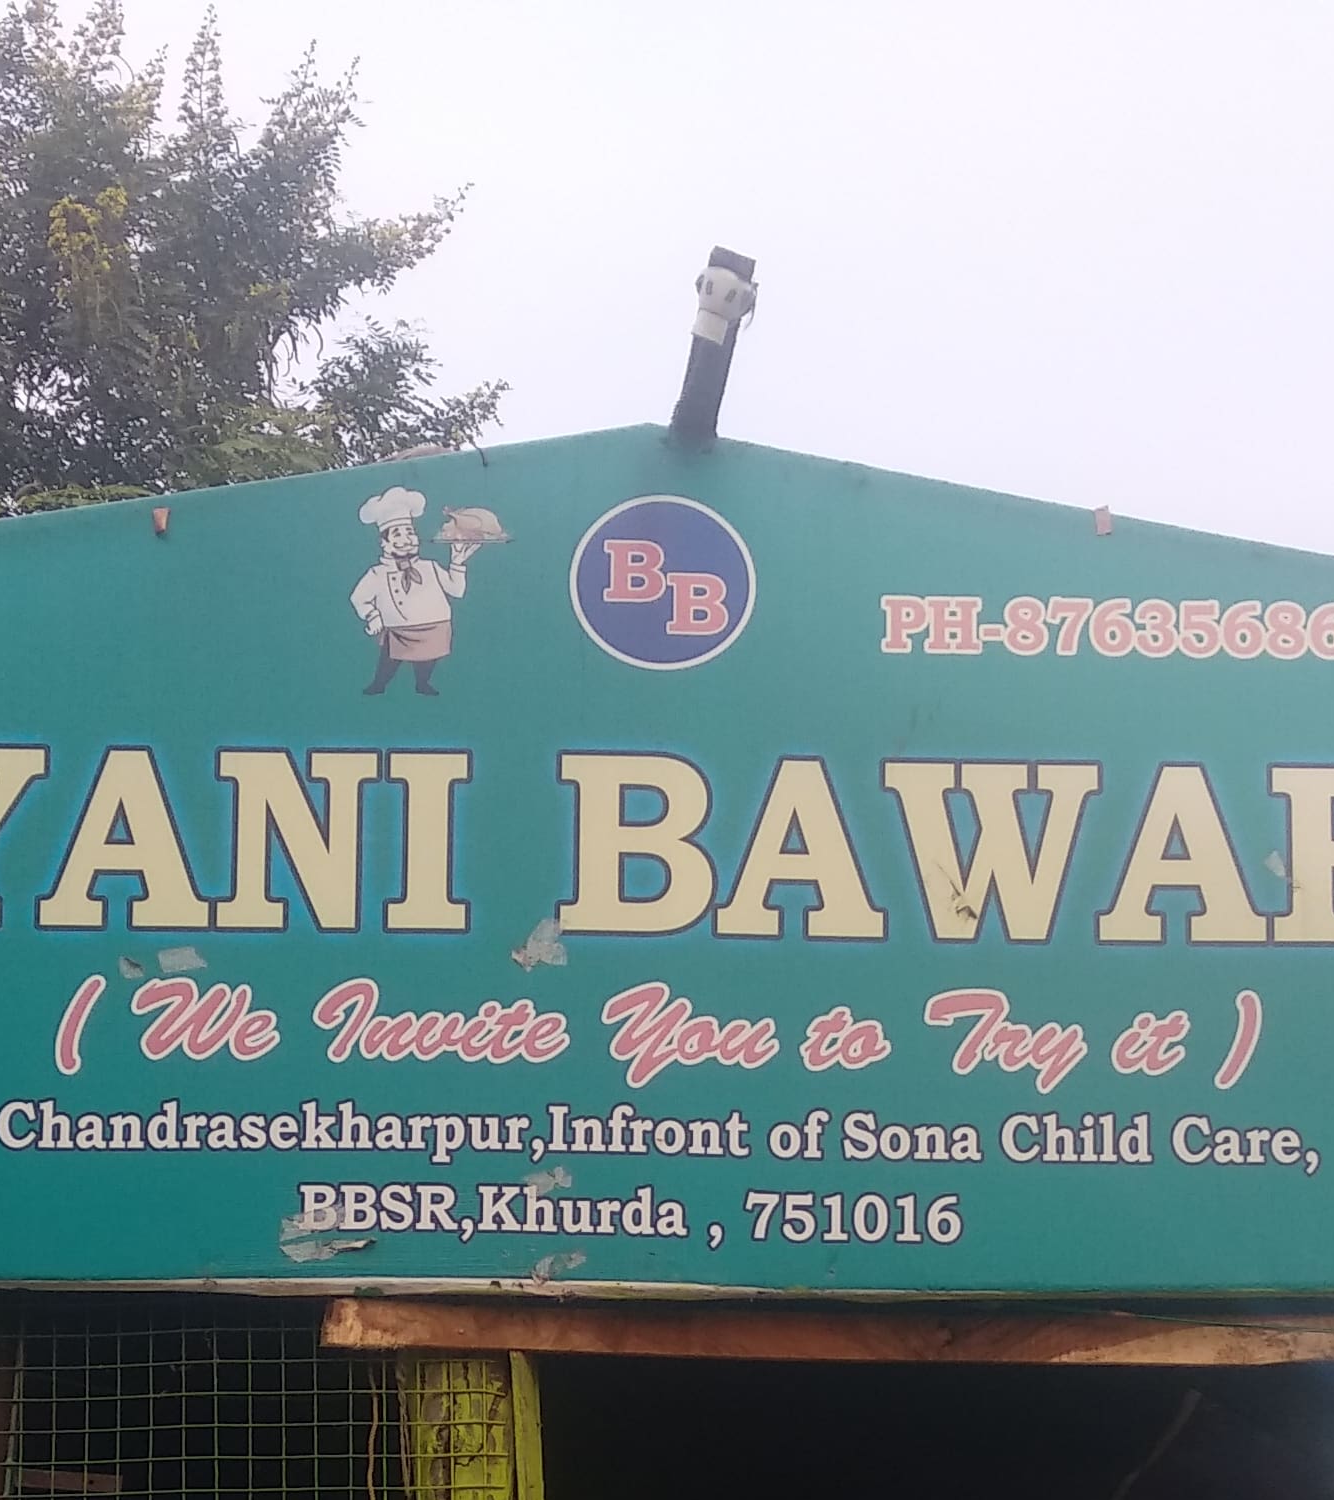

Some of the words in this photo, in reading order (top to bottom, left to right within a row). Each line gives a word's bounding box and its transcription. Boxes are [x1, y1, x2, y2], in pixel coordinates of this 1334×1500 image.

[131, 977, 279, 1061] We
[313, 979, 569, 1062] Invite
[602, 982, 779, 1090] You
[801, 1006, 891, 1071] to
[925, 988, 1087, 1094] Try
[1110, 1011, 1190, 1075] it
[766, 1107, 830, 1161] of
[842, 1111, 982, 1163] Sona
[999, 1112, 1153, 1165] Child
[1170, 1114, 1321, 1175] Care,
[743, 1192, 965, 1245] 751016
